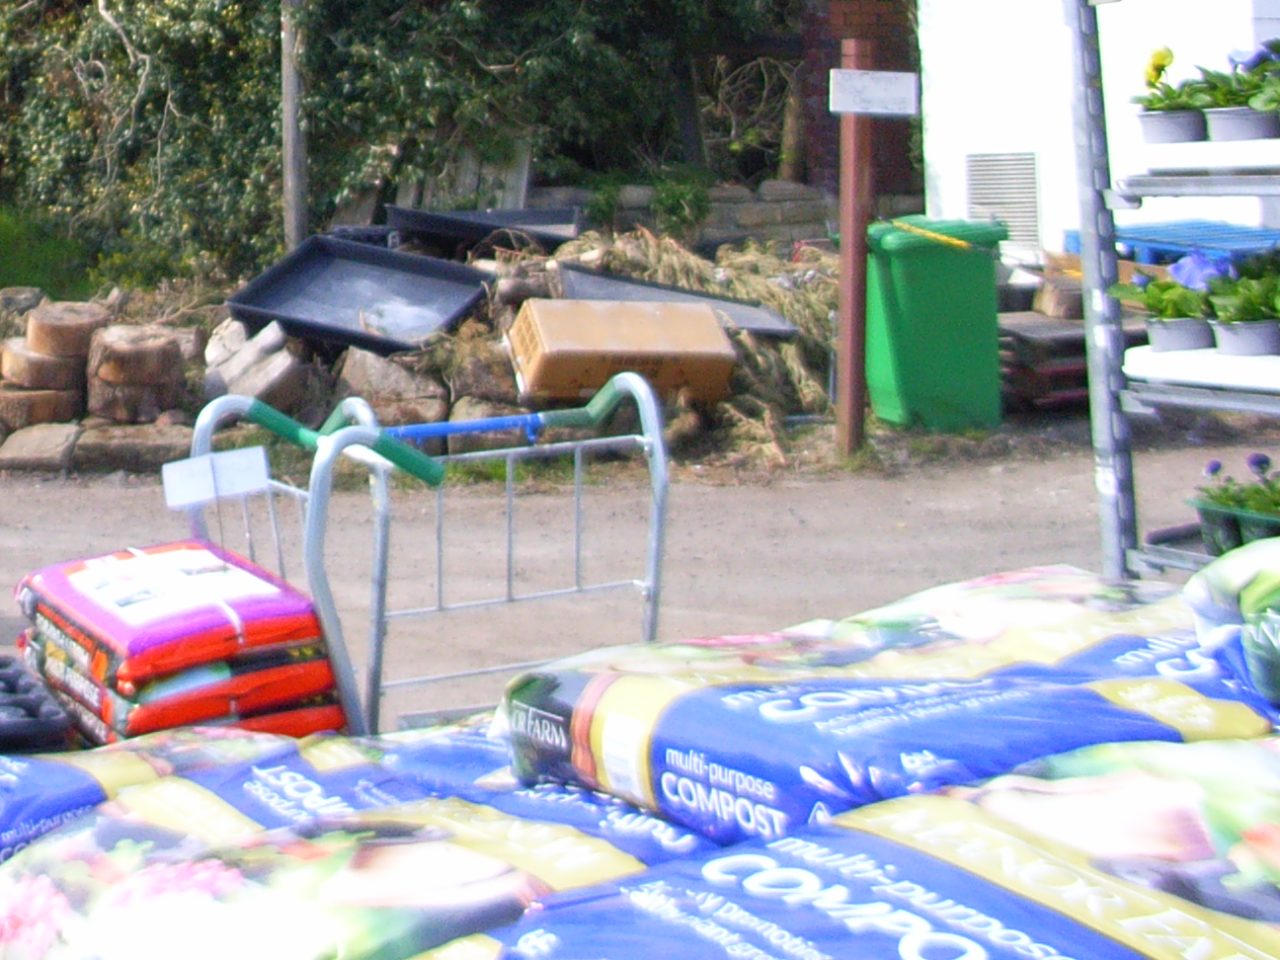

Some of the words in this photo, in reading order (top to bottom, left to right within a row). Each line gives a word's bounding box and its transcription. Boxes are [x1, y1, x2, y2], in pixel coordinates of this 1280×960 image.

[528, 707, 568, 749] FARM
[661, 771, 787, 839] COMPOST
[664, 746, 775, 802] multi-purpose
[767, 836, 1074, 960] multi-purpos
